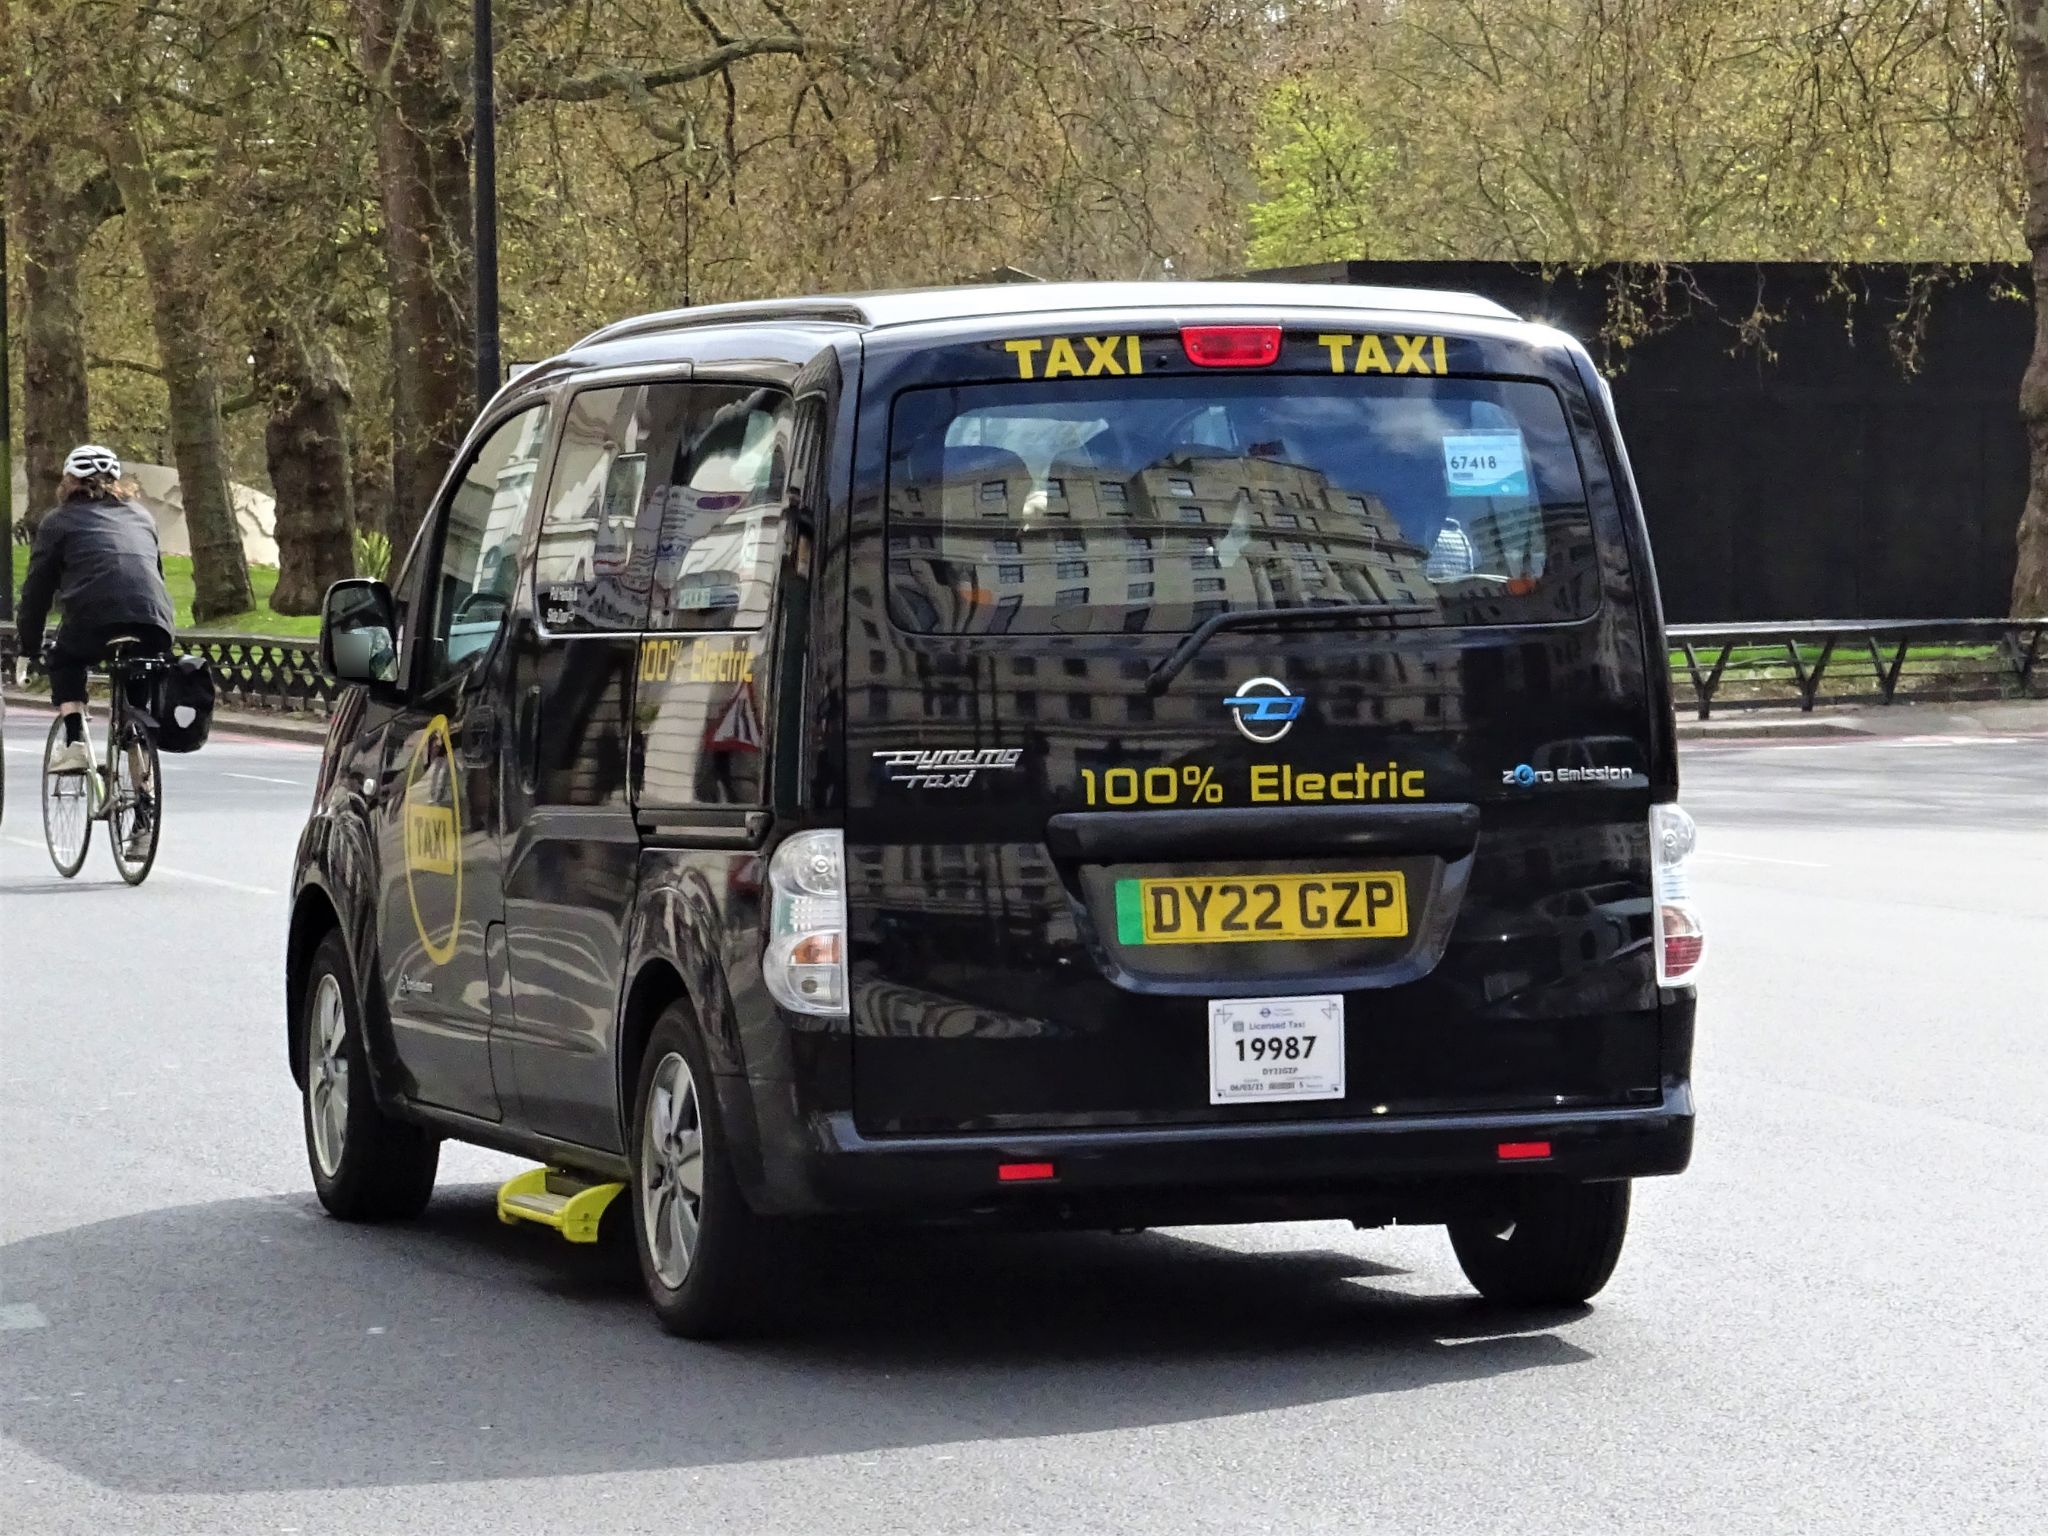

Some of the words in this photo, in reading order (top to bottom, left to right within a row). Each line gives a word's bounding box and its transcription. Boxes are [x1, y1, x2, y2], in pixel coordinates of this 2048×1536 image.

[1005, 335, 1142, 379] TAXI
[1318, 334, 1448, 374] TAXI
[1450, 455, 1497, 470] 67418
[690, 640, 754, 682] Electric
[1081, 765, 1223, 806] 100%
[1250, 761, 1425, 802] Electric
[1556, 765, 1633, 782] Emission
[414, 815, 447, 861] TAXI
[1150, 883, 1283, 934] DY22
[1298, 880, 1395, 929] GZP
[1249, 1021, 1287, 1031] Licensed
[1289, 1020, 1306, 1029] Taxi
[1235, 1035, 1317, 1062] 19987
